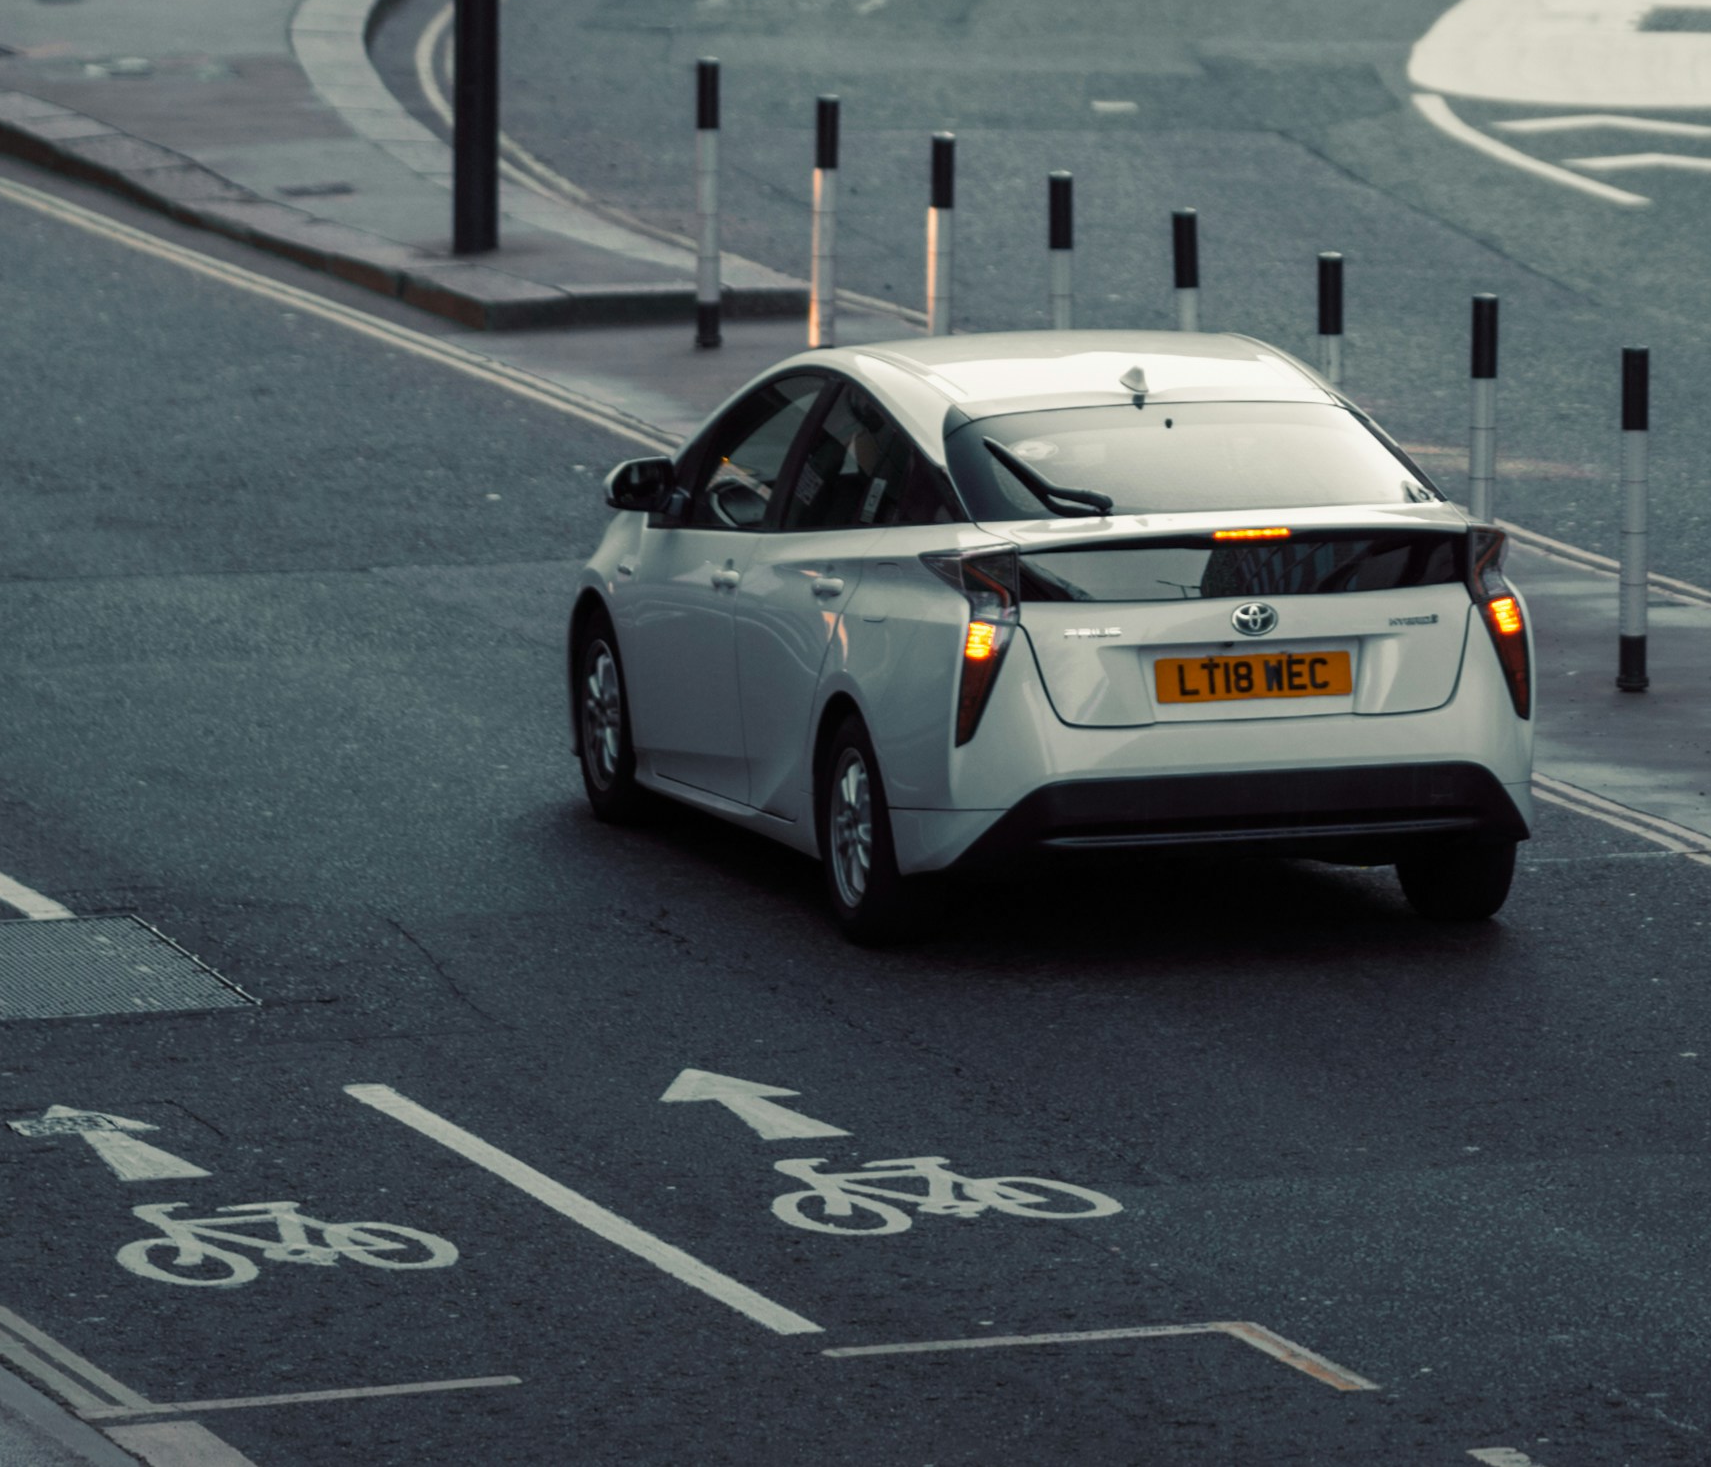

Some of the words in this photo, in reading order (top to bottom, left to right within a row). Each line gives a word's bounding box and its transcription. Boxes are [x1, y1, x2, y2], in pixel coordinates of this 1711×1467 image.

[1064, 626, 1122, 639] PRIUS
[1178, 659, 1254, 696] LT18
[1264, 657, 1330, 692] WEC
